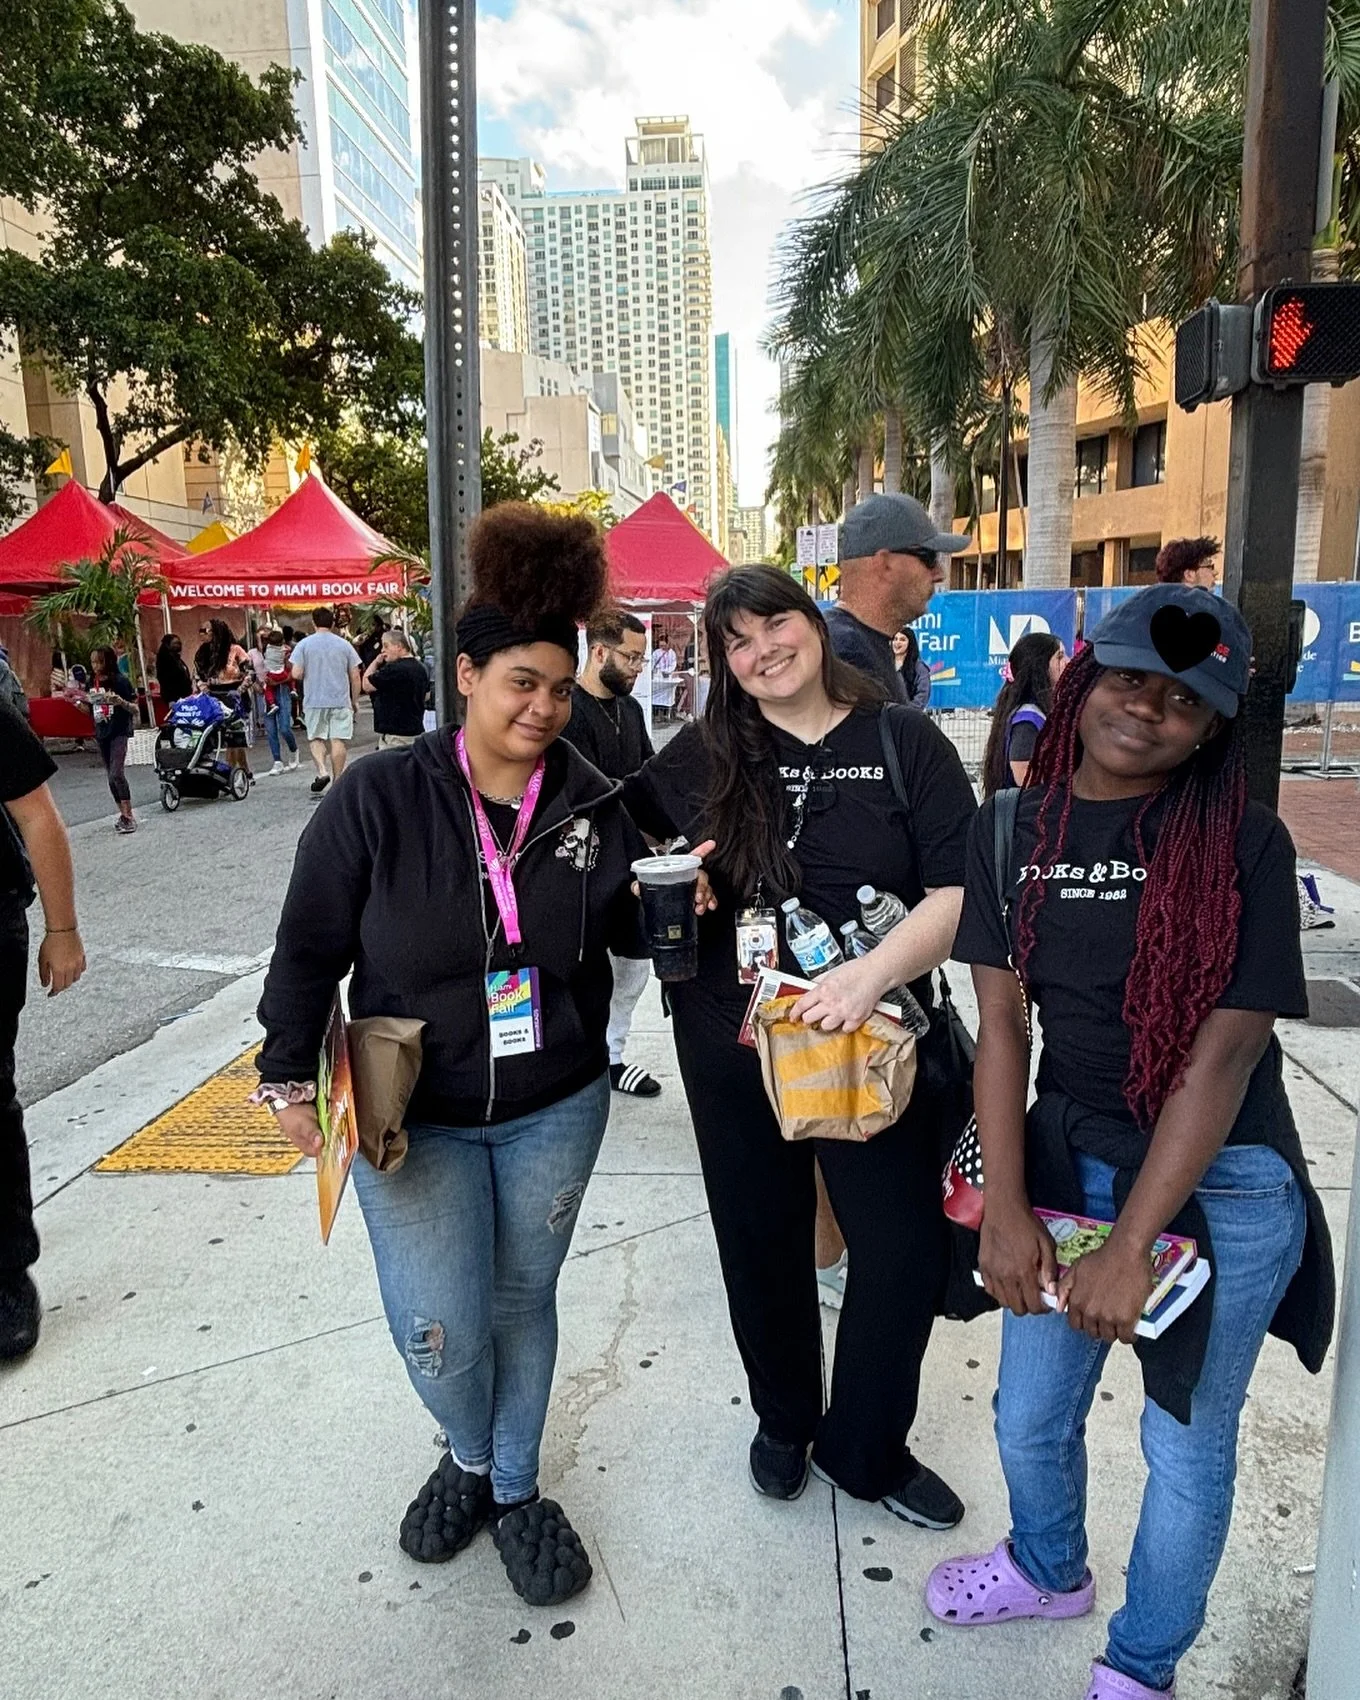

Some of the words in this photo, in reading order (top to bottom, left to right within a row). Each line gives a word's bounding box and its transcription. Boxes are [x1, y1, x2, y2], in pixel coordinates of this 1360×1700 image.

[170, 584, 244, 598] WELCOME
[249, 584, 269, 597] TO
[274, 583, 316, 596] MIAMI
[322, 582, 362, 595] BOOK
[367, 582, 399, 595] FAIR
[919, 633, 960, 651] Fair
[1089, 862, 1107, 883] &
[1060, 888, 1095, 899] SINCE
[1098, 889, 1127, 900] 1982
[491, 989, 524, 1003] Book
[491, 1003, 516, 1014] Fair
